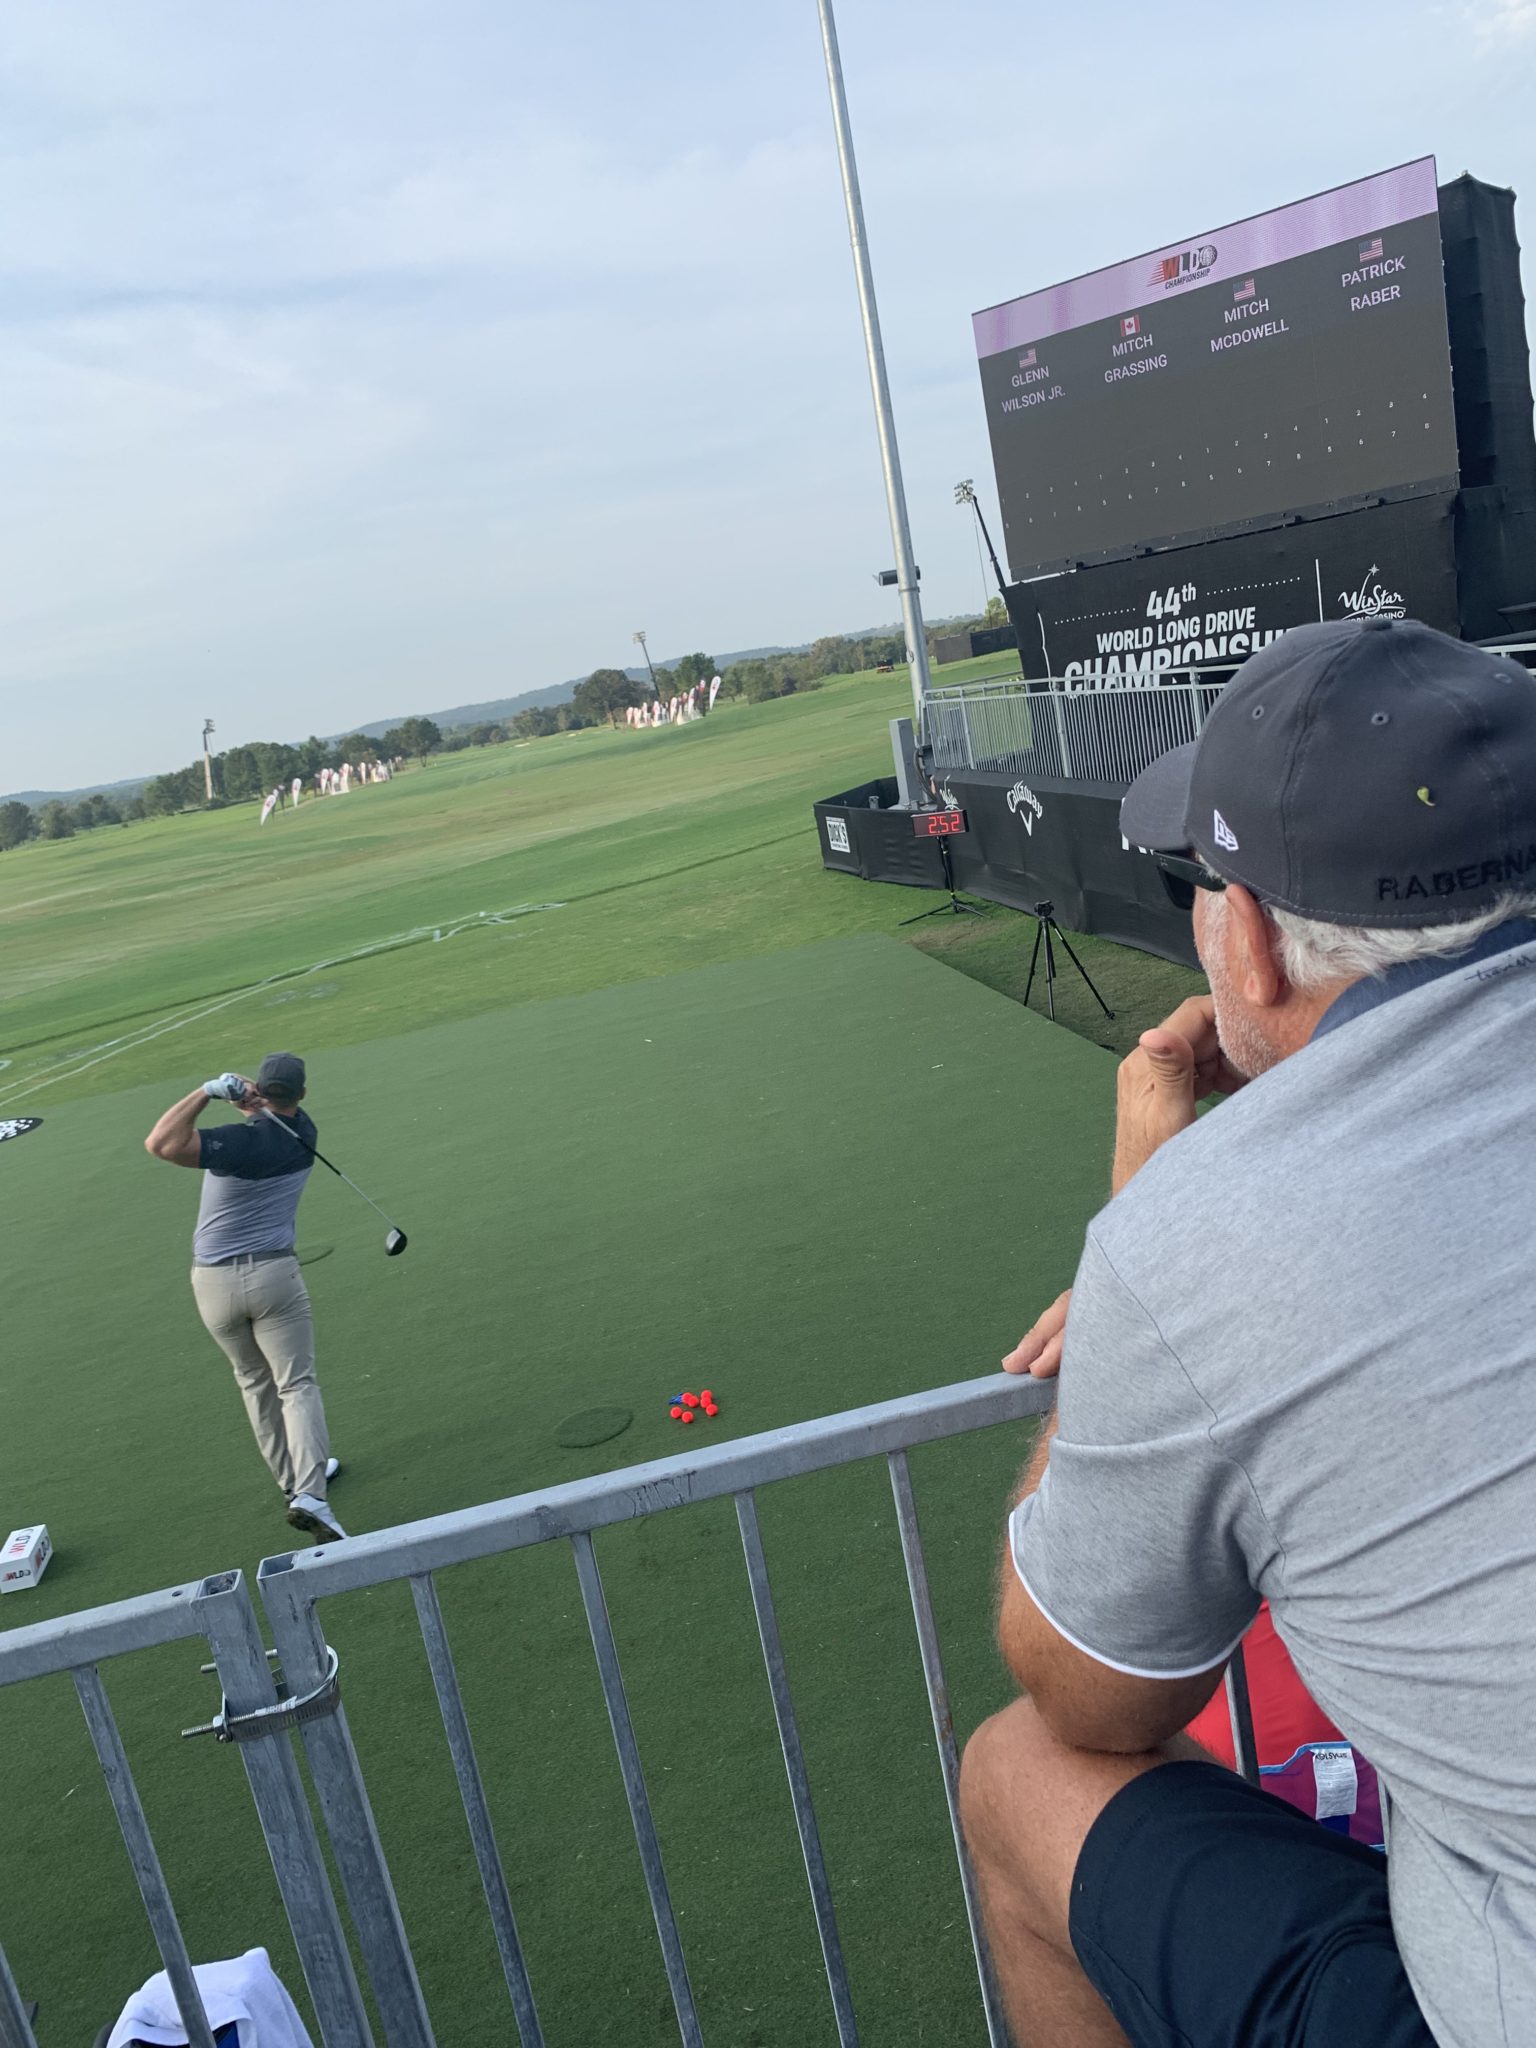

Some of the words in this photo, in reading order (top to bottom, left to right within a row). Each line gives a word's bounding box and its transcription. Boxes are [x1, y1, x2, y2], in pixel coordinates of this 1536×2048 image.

[1165, 268, 1211, 290] CHAMPIONSHIP
[1341, 255, 1406, 288] PATRICK
[1224, 298, 1270, 324] MITCH
[1350, 284, 1401, 312] RABER
[1112, 333, 1153, 358] MITCH
[1210, 319, 1290, 353] MCDOWELL
[1011, 366, 1050, 388] GLENN
[1104, 353, 1168, 383] GRASSING
[1001, 389, 1046, 413] WILSON
[1048, 385, 1066, 400] JR.
[1146, 583, 1197, 619] 44th
[1337, 585, 1404, 615] WinStar
[1096, 626, 1153, 654] WORLD
[1157, 616, 1201, 645] LONG
[1205, 606, 1256, 635] DRIVE
[1064, 628, 1296, 693] CHAMPIONSHI
[1006, 779, 1043, 820] Callaway
